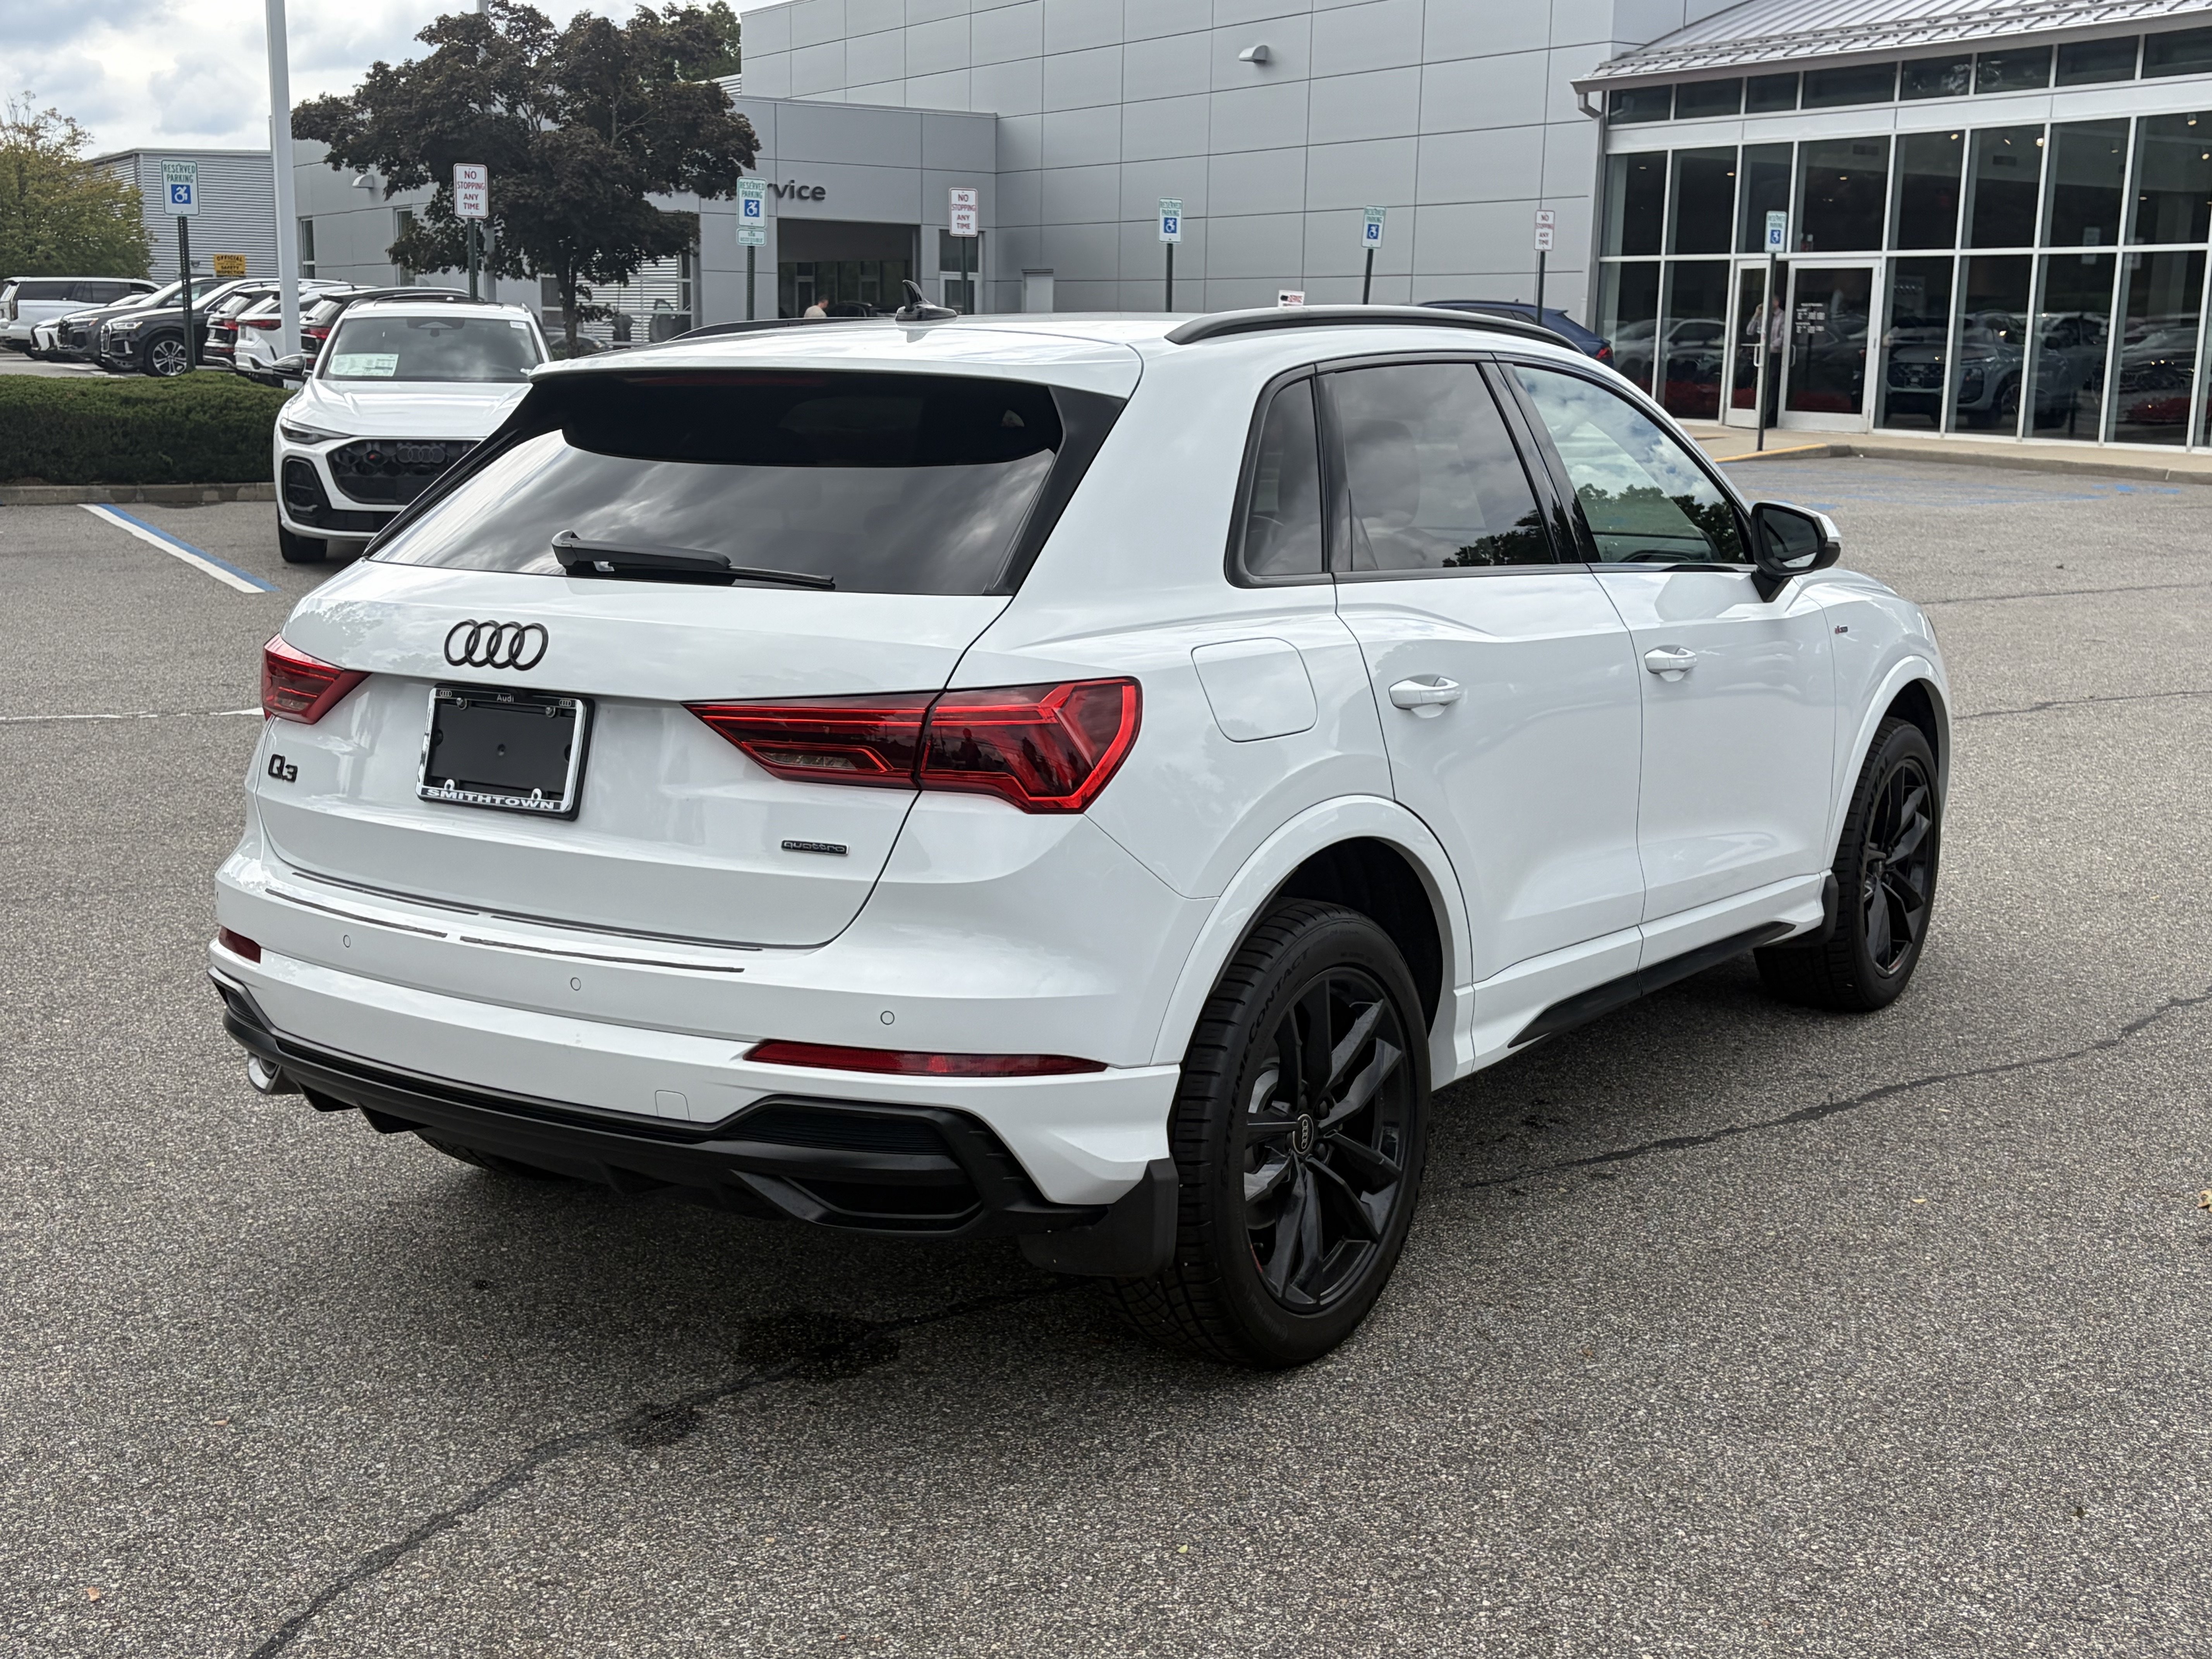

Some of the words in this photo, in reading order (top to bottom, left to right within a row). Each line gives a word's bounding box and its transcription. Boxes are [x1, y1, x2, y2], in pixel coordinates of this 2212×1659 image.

[163, 164, 195, 173] RESERVED
[167, 173, 193, 183] PARKING
[464, 170, 477, 179] NO
[457, 181, 485, 190] STOPPING
[739, 181, 765, 191] RESERVED
[741, 190, 763, 199] PARKING
[958, 194, 969, 202] NO
[1541, 214, 1549, 222] NO
[496, 694, 514, 703] Audi
[268, 754, 298, 783] Q3
[426, 789, 554, 809] SMITHTOWN
[784, 842, 845, 852] quattro
